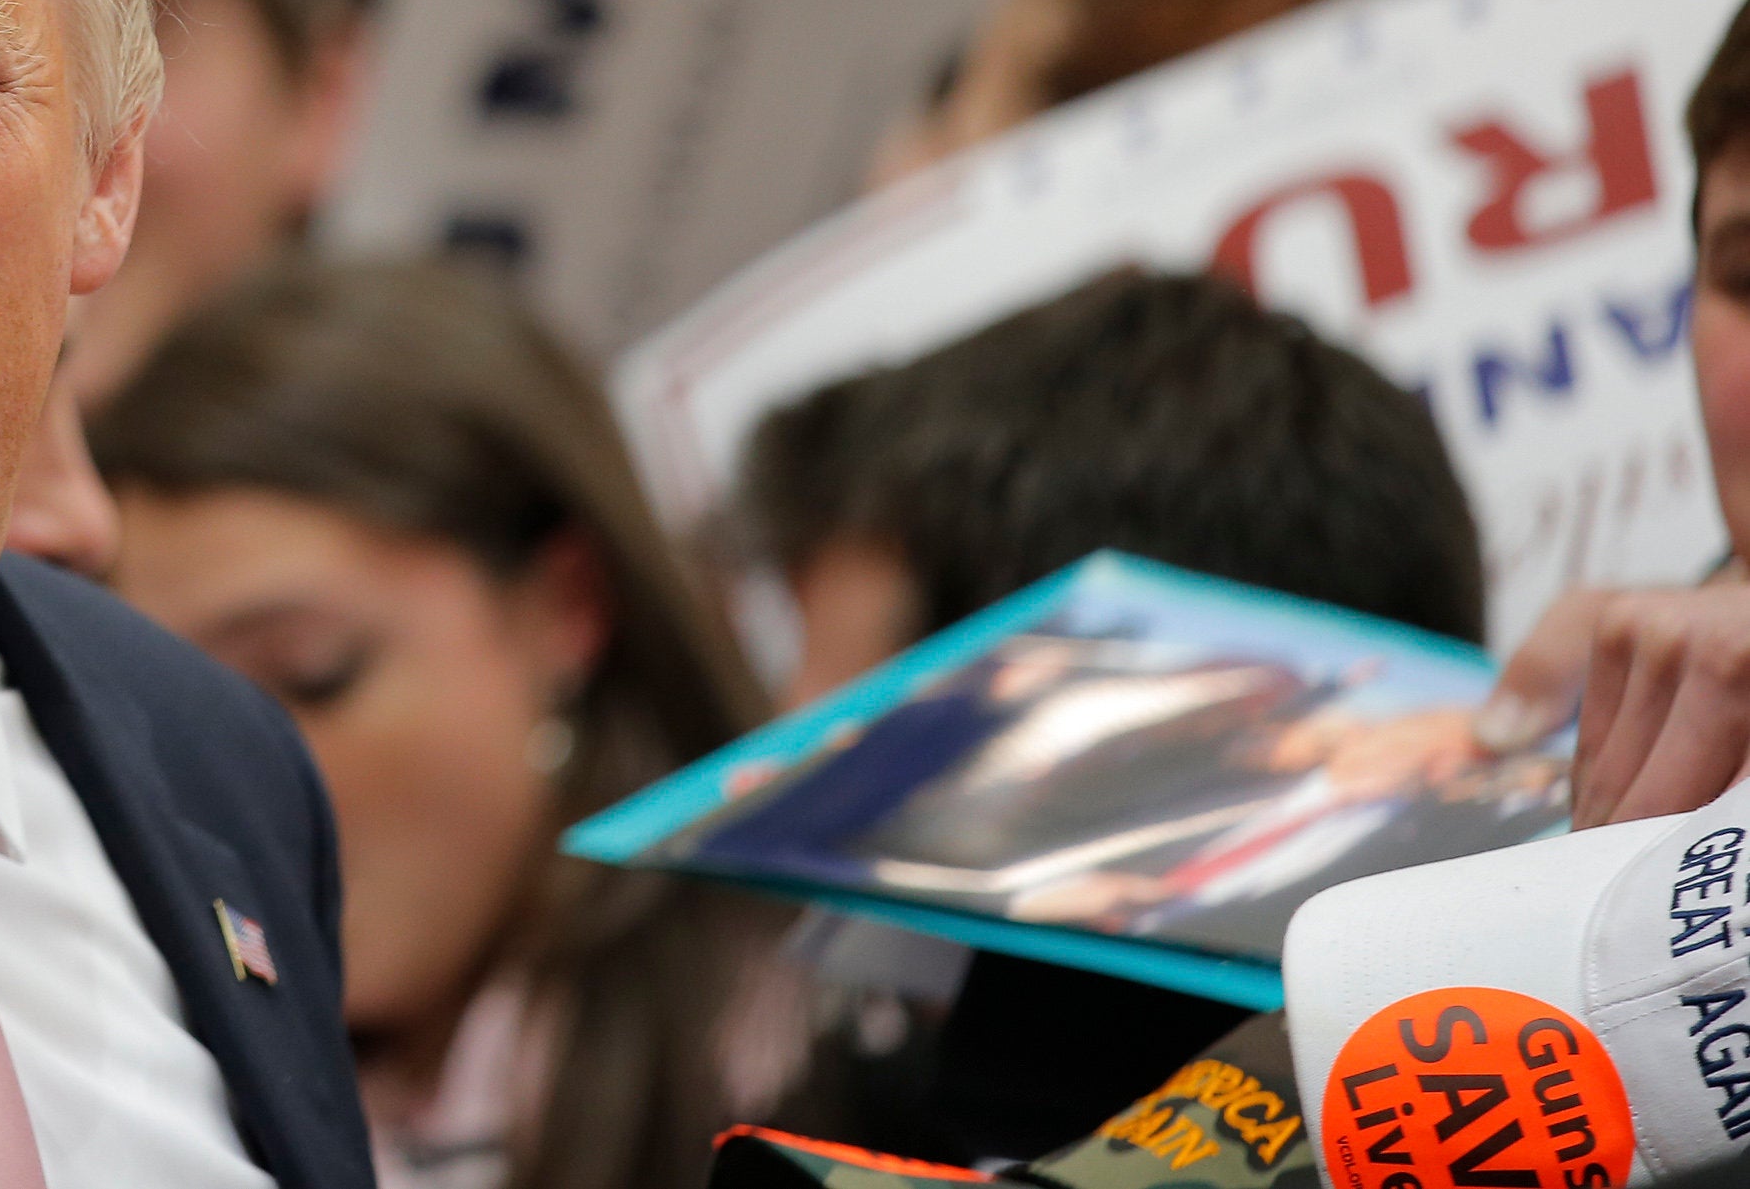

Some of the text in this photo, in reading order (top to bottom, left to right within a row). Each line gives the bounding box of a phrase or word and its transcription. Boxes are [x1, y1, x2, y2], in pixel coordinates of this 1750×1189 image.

[1205, 62, 1662, 317] RU
[1415, 277, 1695, 427] AN
[1670, 826, 1750, 1141] GREAT AGAI
[1397, 1004, 1545, 1189] SAV
